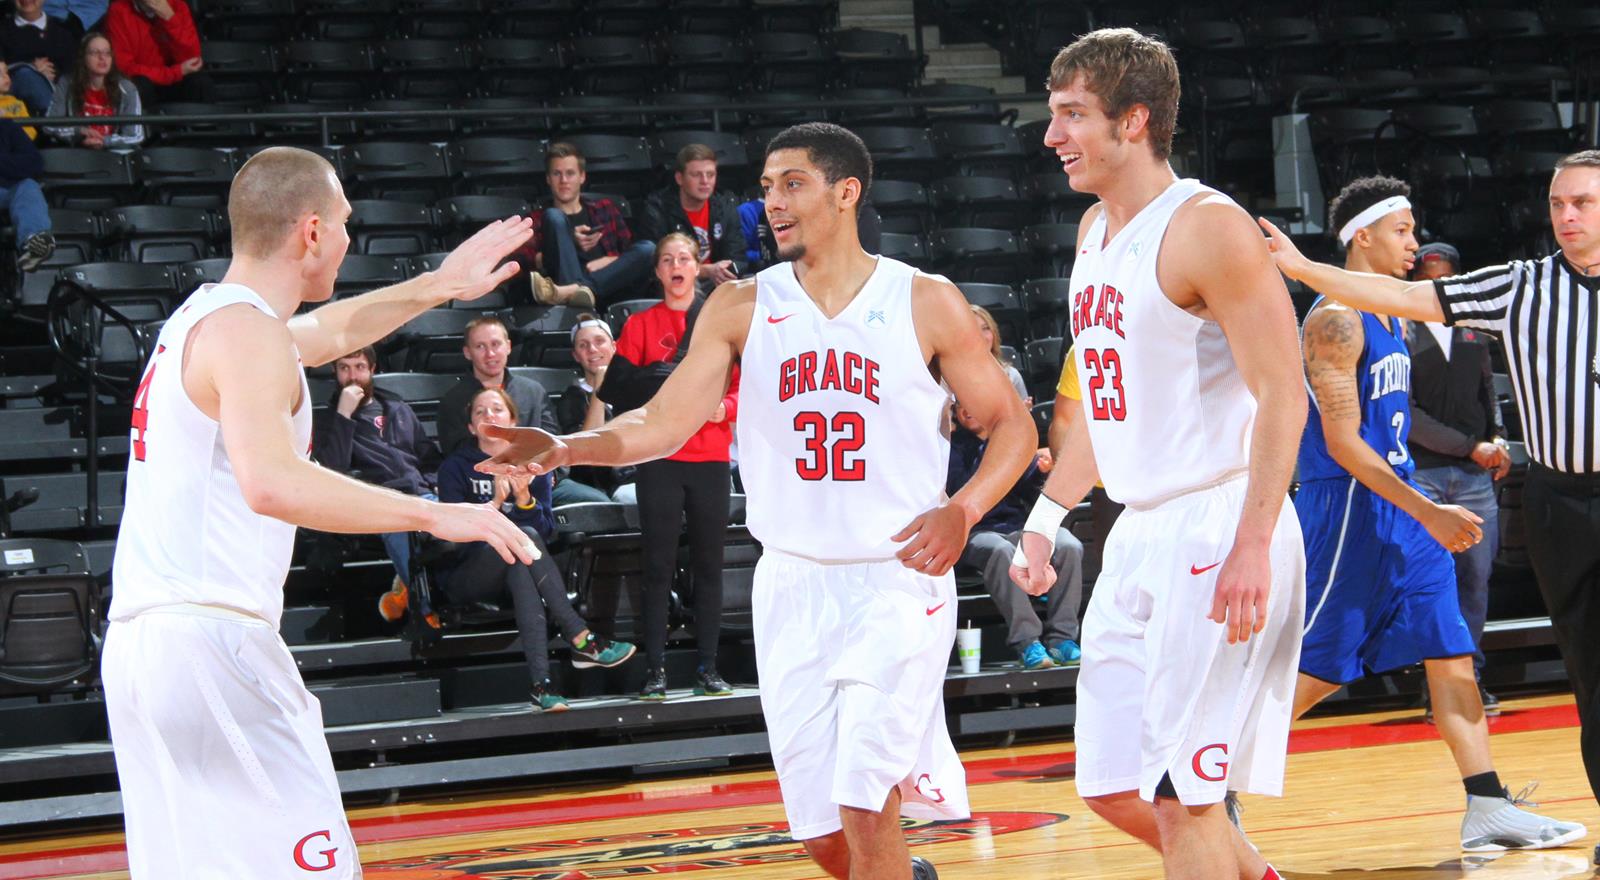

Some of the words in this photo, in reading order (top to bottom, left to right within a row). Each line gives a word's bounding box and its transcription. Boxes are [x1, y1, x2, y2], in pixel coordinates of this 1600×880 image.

[1072, 282, 1126, 340] GRACE
[778, 348, 880, 405] GRACE
[1083, 347, 1127, 422] 23
[793, 411, 866, 481] 32
[1387, 409, 1409, 466] 3
[558, 515, 567, 524] 11
[914, 773, 946, 804] G
[1191, 742, 1229, 782] G
[293, 829, 339, 872] G
